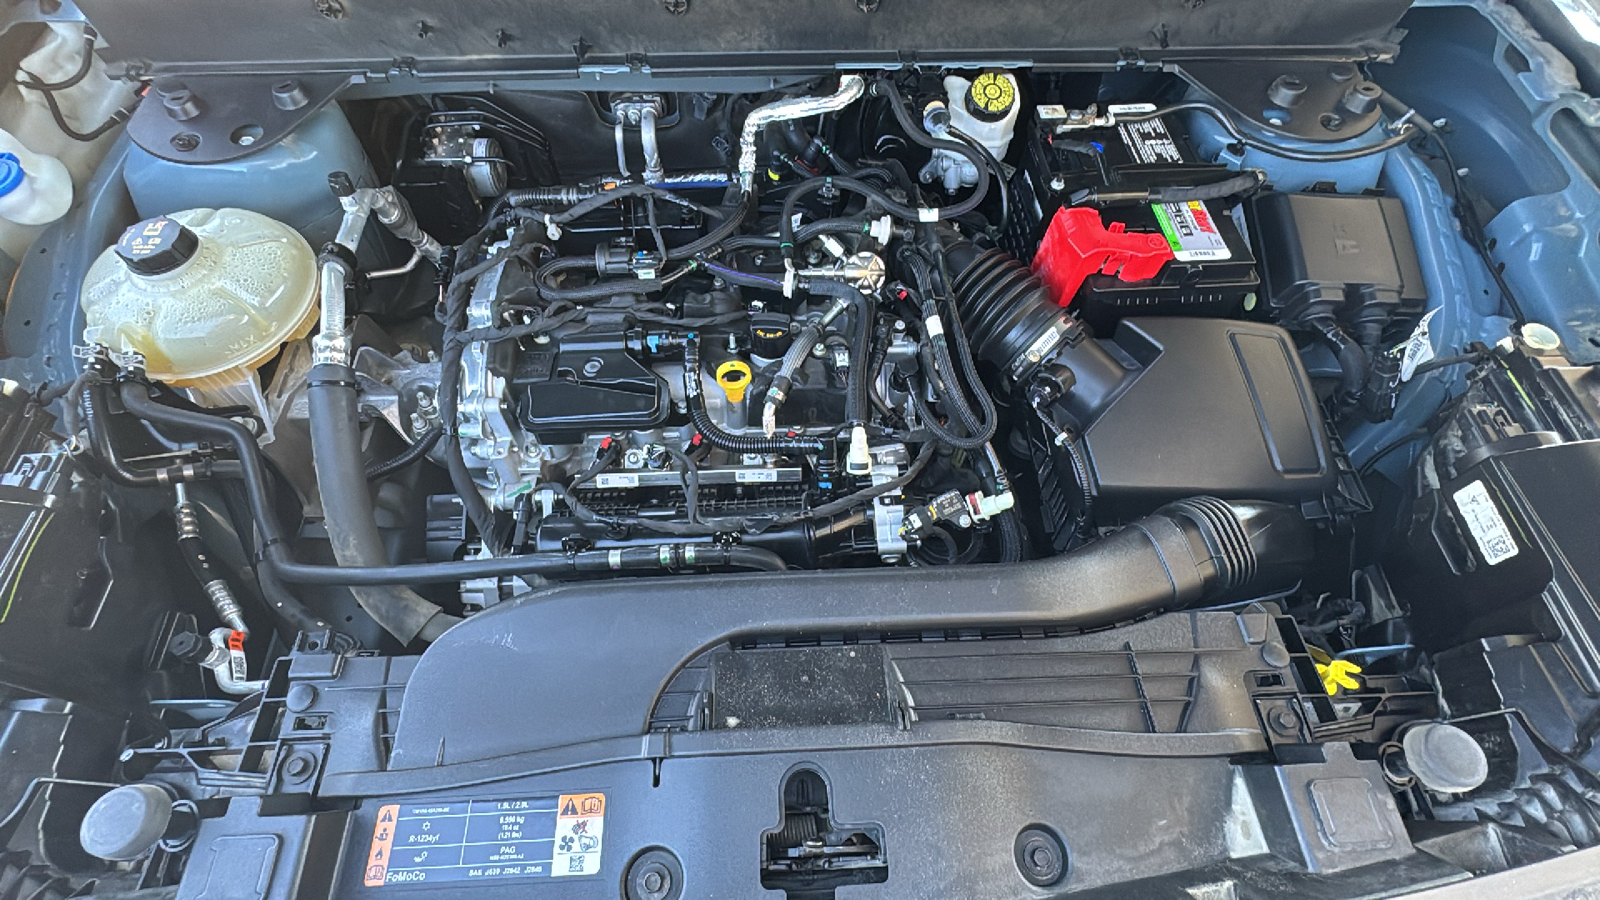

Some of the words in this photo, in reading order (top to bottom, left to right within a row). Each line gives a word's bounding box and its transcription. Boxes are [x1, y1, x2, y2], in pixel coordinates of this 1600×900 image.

[408, 833, 440, 844] R-1234yf
[500, 846, 516, 854] PAG
[386, 871, 426, 882] FoMoCo
